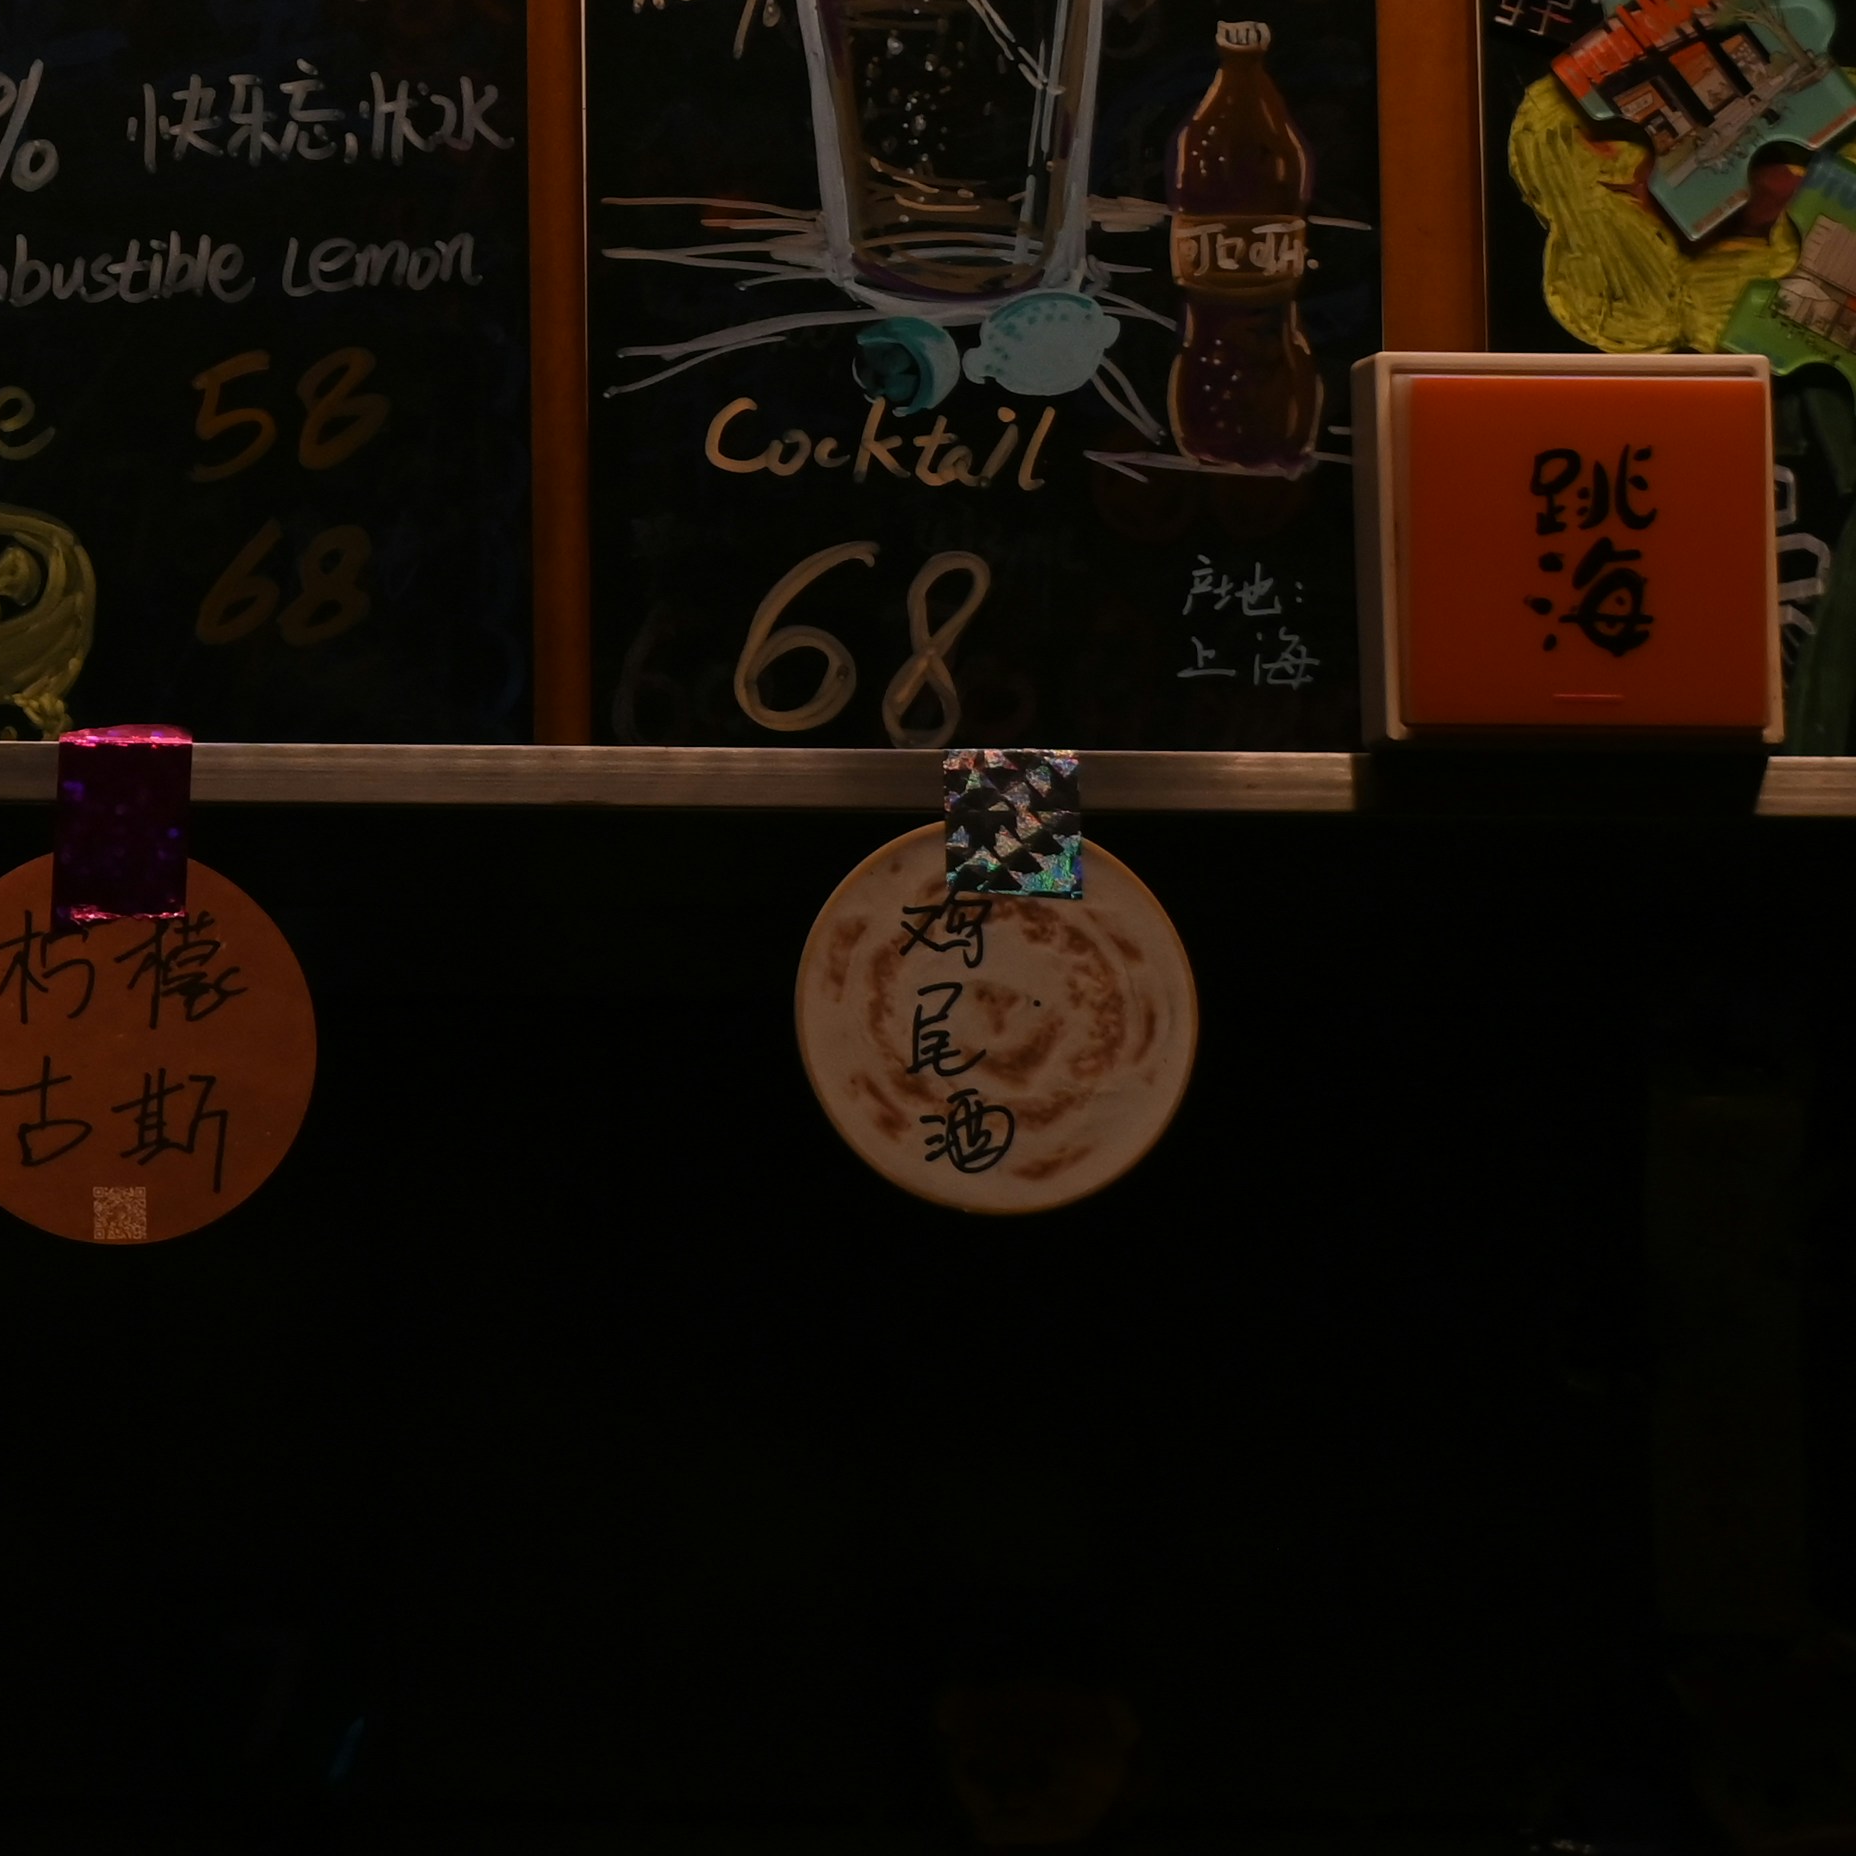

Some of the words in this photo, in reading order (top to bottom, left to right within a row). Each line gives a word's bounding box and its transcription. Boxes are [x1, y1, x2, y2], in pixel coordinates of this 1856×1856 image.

[188, 347, 391, 484] 58
[704, 396, 1058, 492] Cocktail
[194, 519, 372, 649] 68
[1523, 443, 1658, 657] 跳海
[734, 540, 992, 748] 68
[1175, 629, 1321, 691] 上海
[899, 889, 1016, 1173] 鸡尾酒
